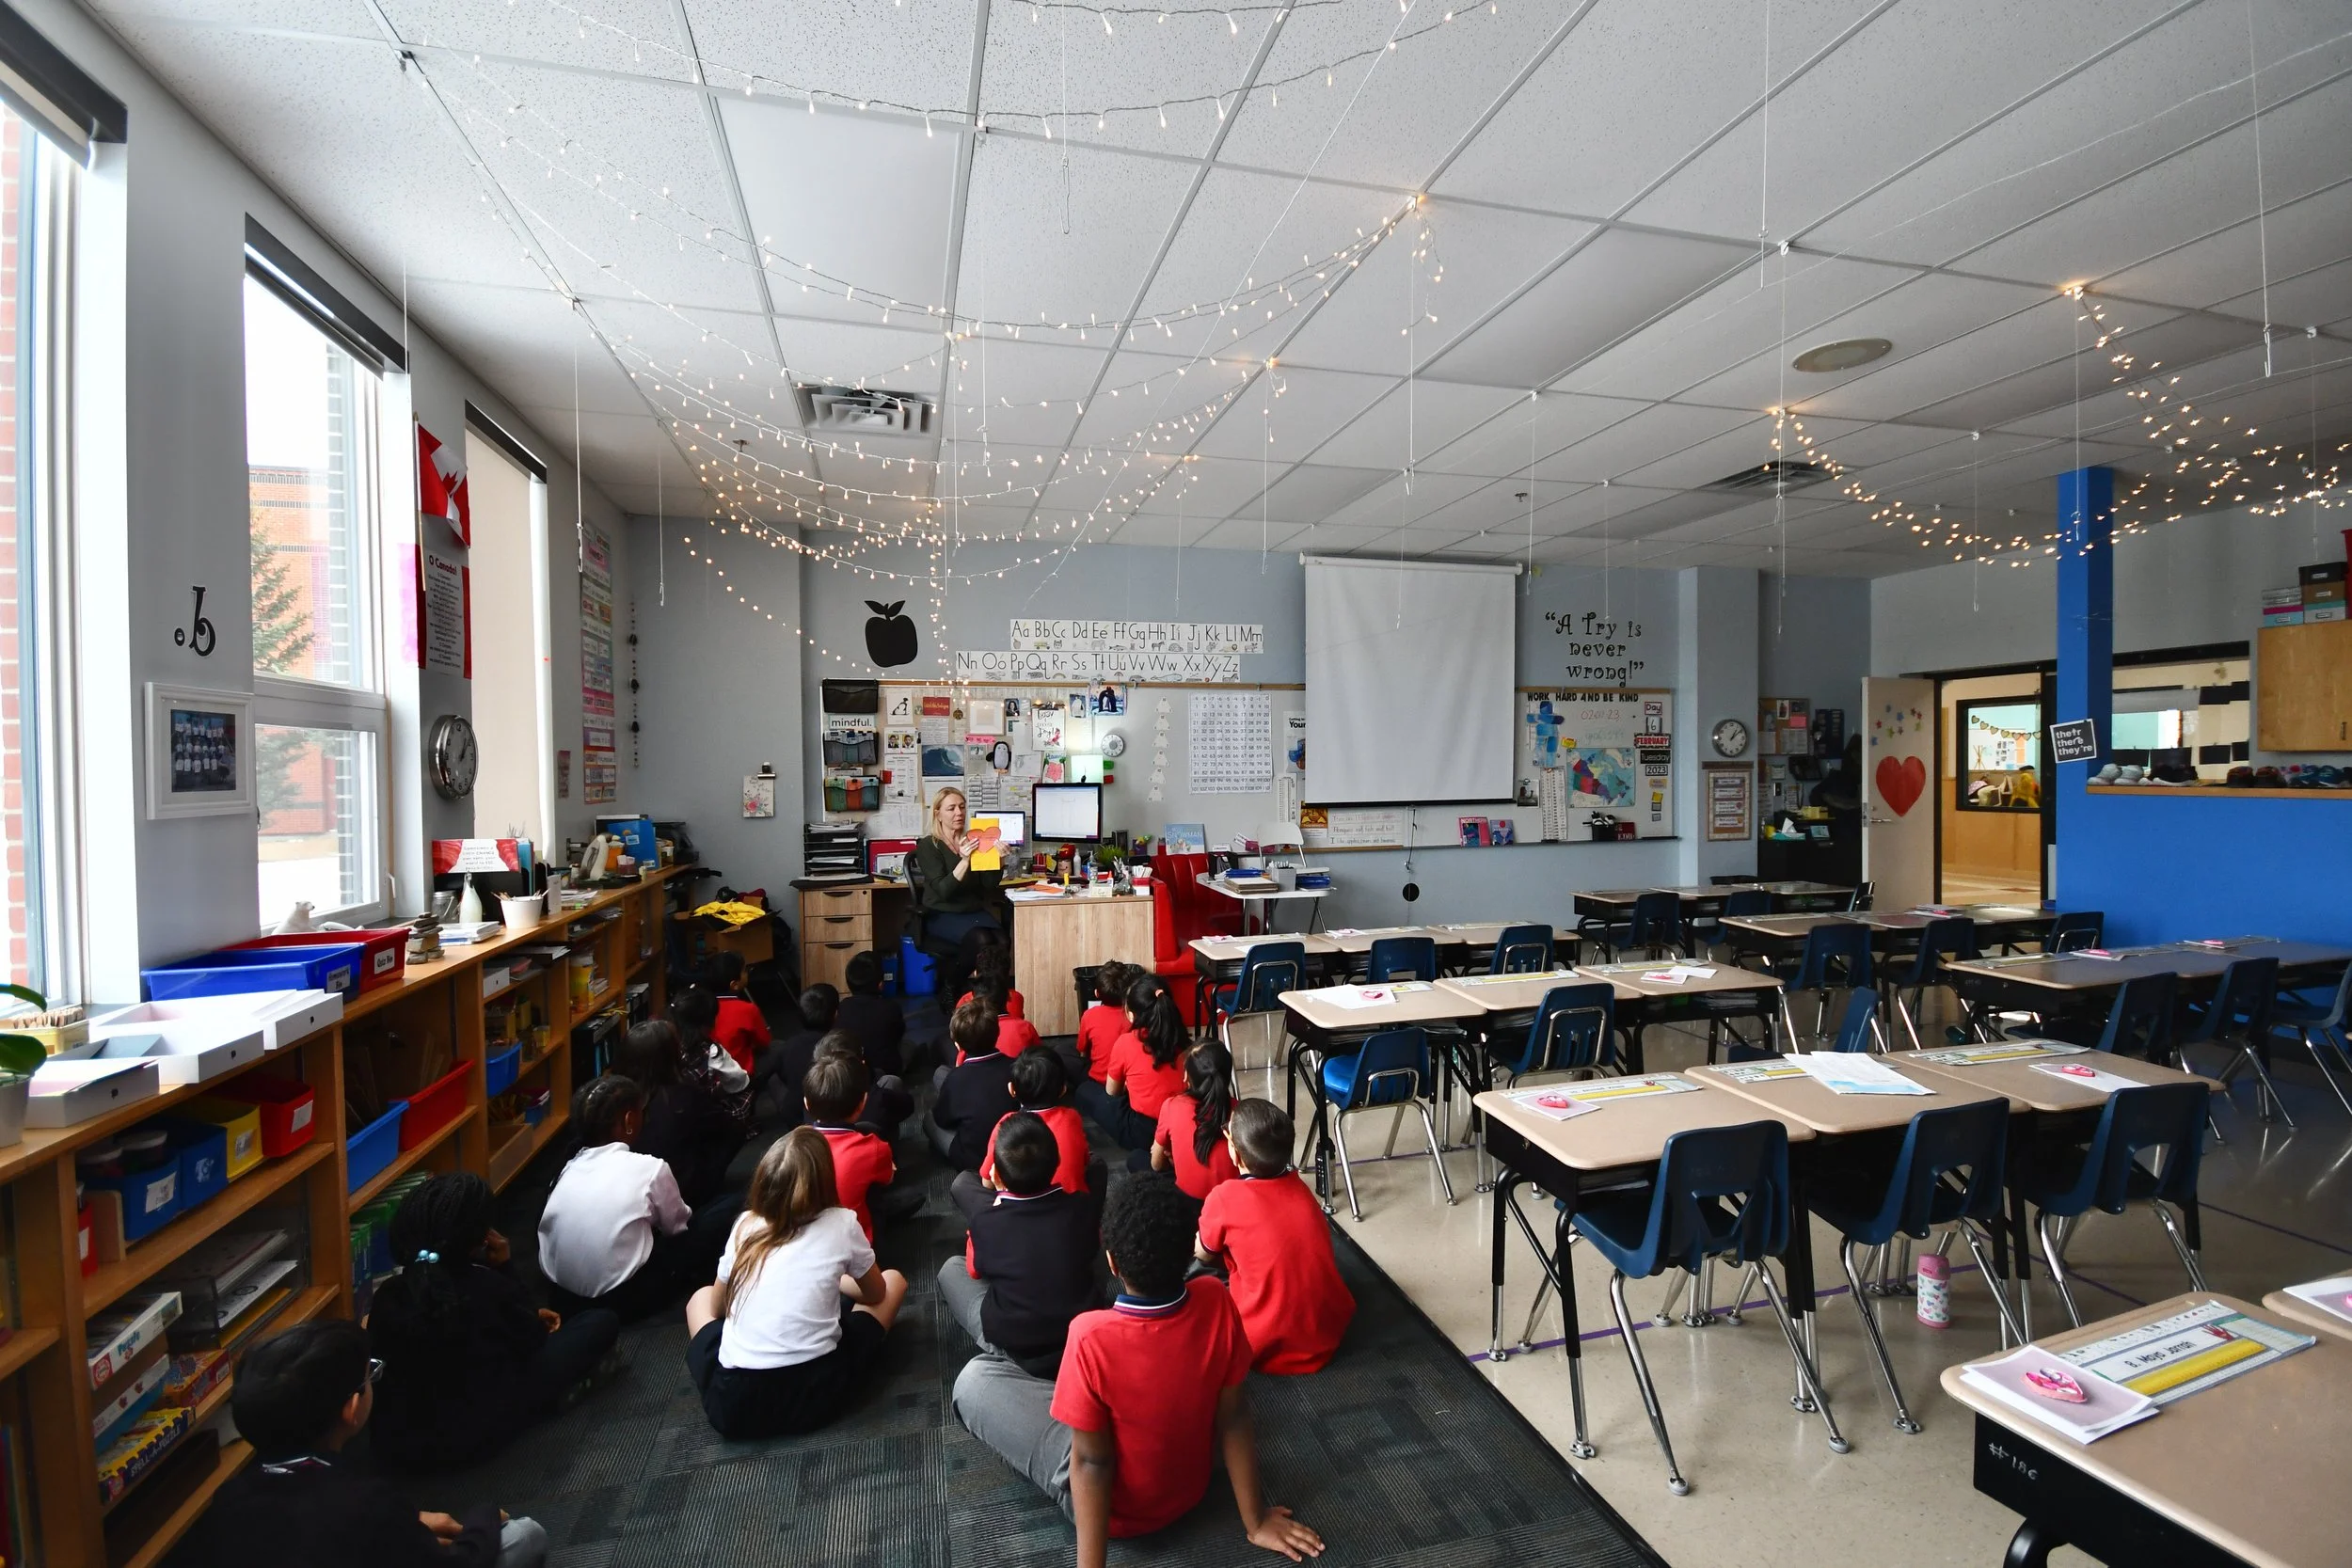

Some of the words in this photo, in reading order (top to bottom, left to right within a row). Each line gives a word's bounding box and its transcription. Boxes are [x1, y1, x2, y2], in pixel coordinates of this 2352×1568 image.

[1581, 611, 1617, 640] Try
[1628, 621, 1642, 637] is
[1035, 621, 1050, 638] Bb
[1052, 621, 1066, 638] Cc
[1073, 621, 1088, 639] Dd
[1114, 622, 1127, 639] Ff
[1129, 623, 1146, 649] Gg
[1148, 624, 1167, 640] Hh
[1187, 624, 1200, 650] Jj
[1205, 625, 1220, 641] Kk
[1241, 626, 1263, 641] Mm
[1569, 641, 1626, 657] never
[958, 652, 977, 670] Nn
[1010, 653, 1025, 679] Pp
[1026, 653, 1051, 680] Qq
[1052, 654, 1067, 670] Rr
[1072, 654, 1087, 670] Ss
[1091, 653, 1104, 671] Tt
[1129, 655, 1145, 671] Vv
[1148, 655, 1177, 671] Ww
[1183, 655, 1200, 672] Xx
[1222, 656, 1238, 672] Zz
[1527, 691, 1549, 702] WORK
[1555, 692, 1577, 702] HARD
[1581, 692, 1599, 702] AND
[1603, 693, 1613, 702] BE
[1619, 692, 1639, 702] KIND
[1646, 704, 1661, 714] Day
[831, 718, 872, 727] mindful.
[1650, 719, 1656, 731] 6
[1636, 736, 1668, 745] FEBRUARY
[2058, 736, 2084, 747] there
[2058, 745, 2092, 755] they're
[1641, 752, 1670, 763] Tuesday
[131, 1425, 181, 1478] SPELL-A-PUZZLE
